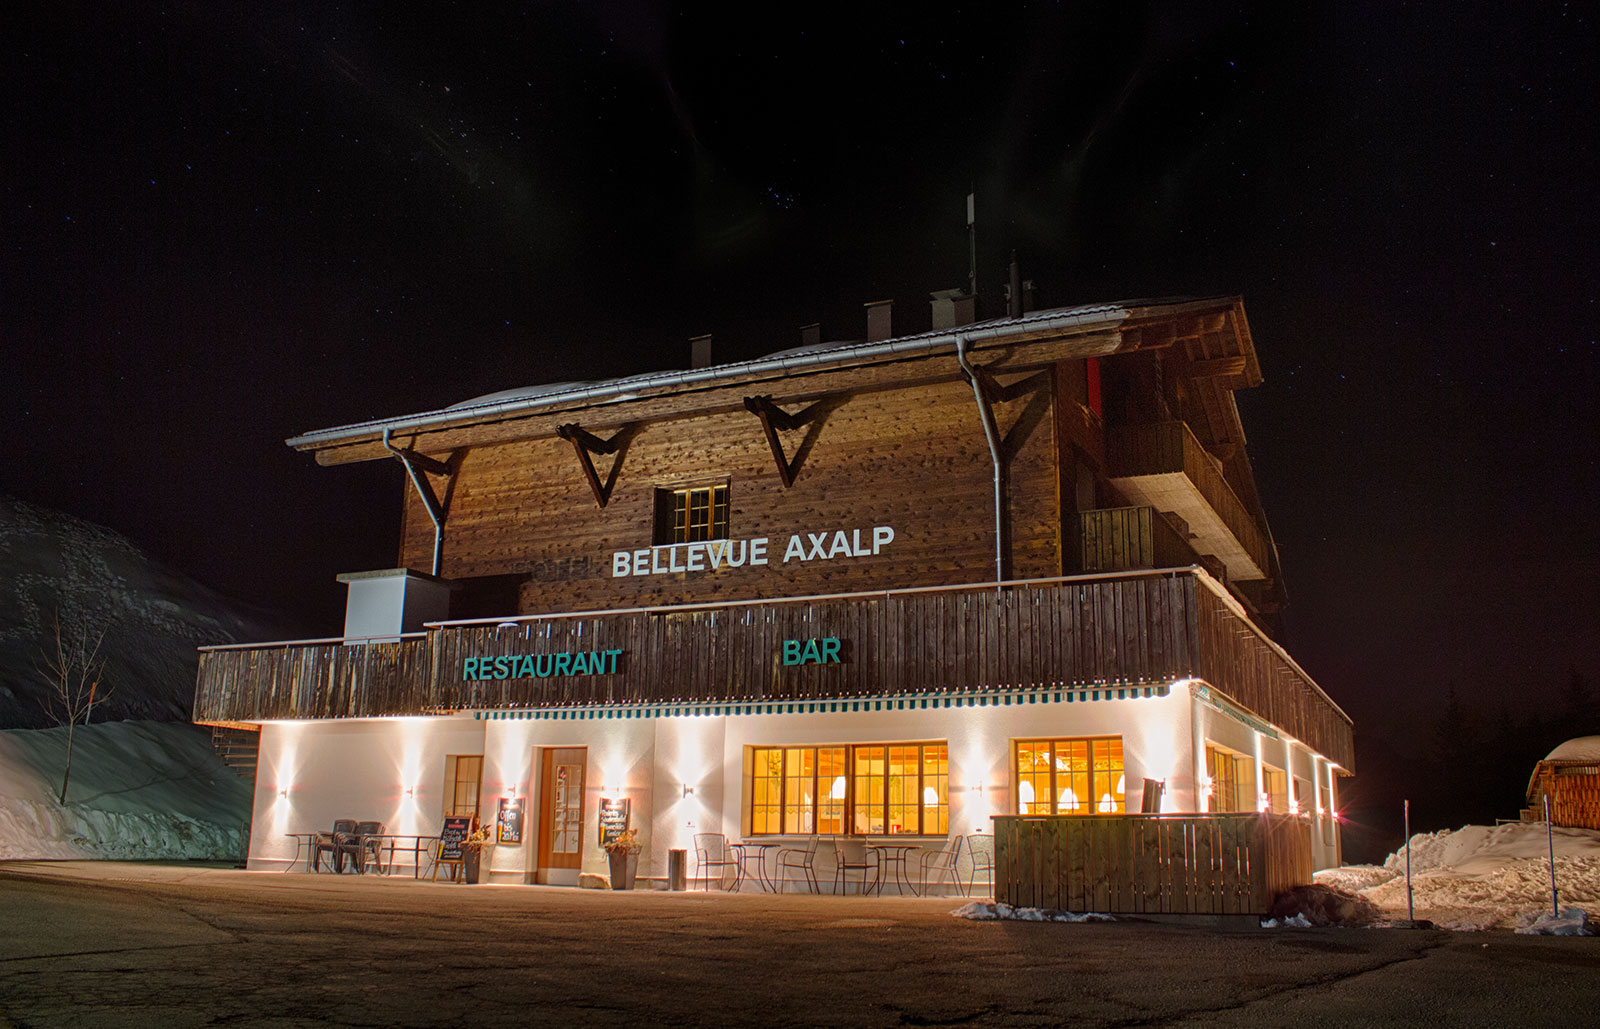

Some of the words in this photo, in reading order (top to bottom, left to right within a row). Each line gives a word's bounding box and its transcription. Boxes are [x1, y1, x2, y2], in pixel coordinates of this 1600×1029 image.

[612, 537, 769, 578] BELLEVUE
[783, 526, 895, 563] AXALP
[463, 649, 623, 681] RESTAURANT
[783, 636, 842, 667] BAR
[500, 810, 516, 822] Offen
